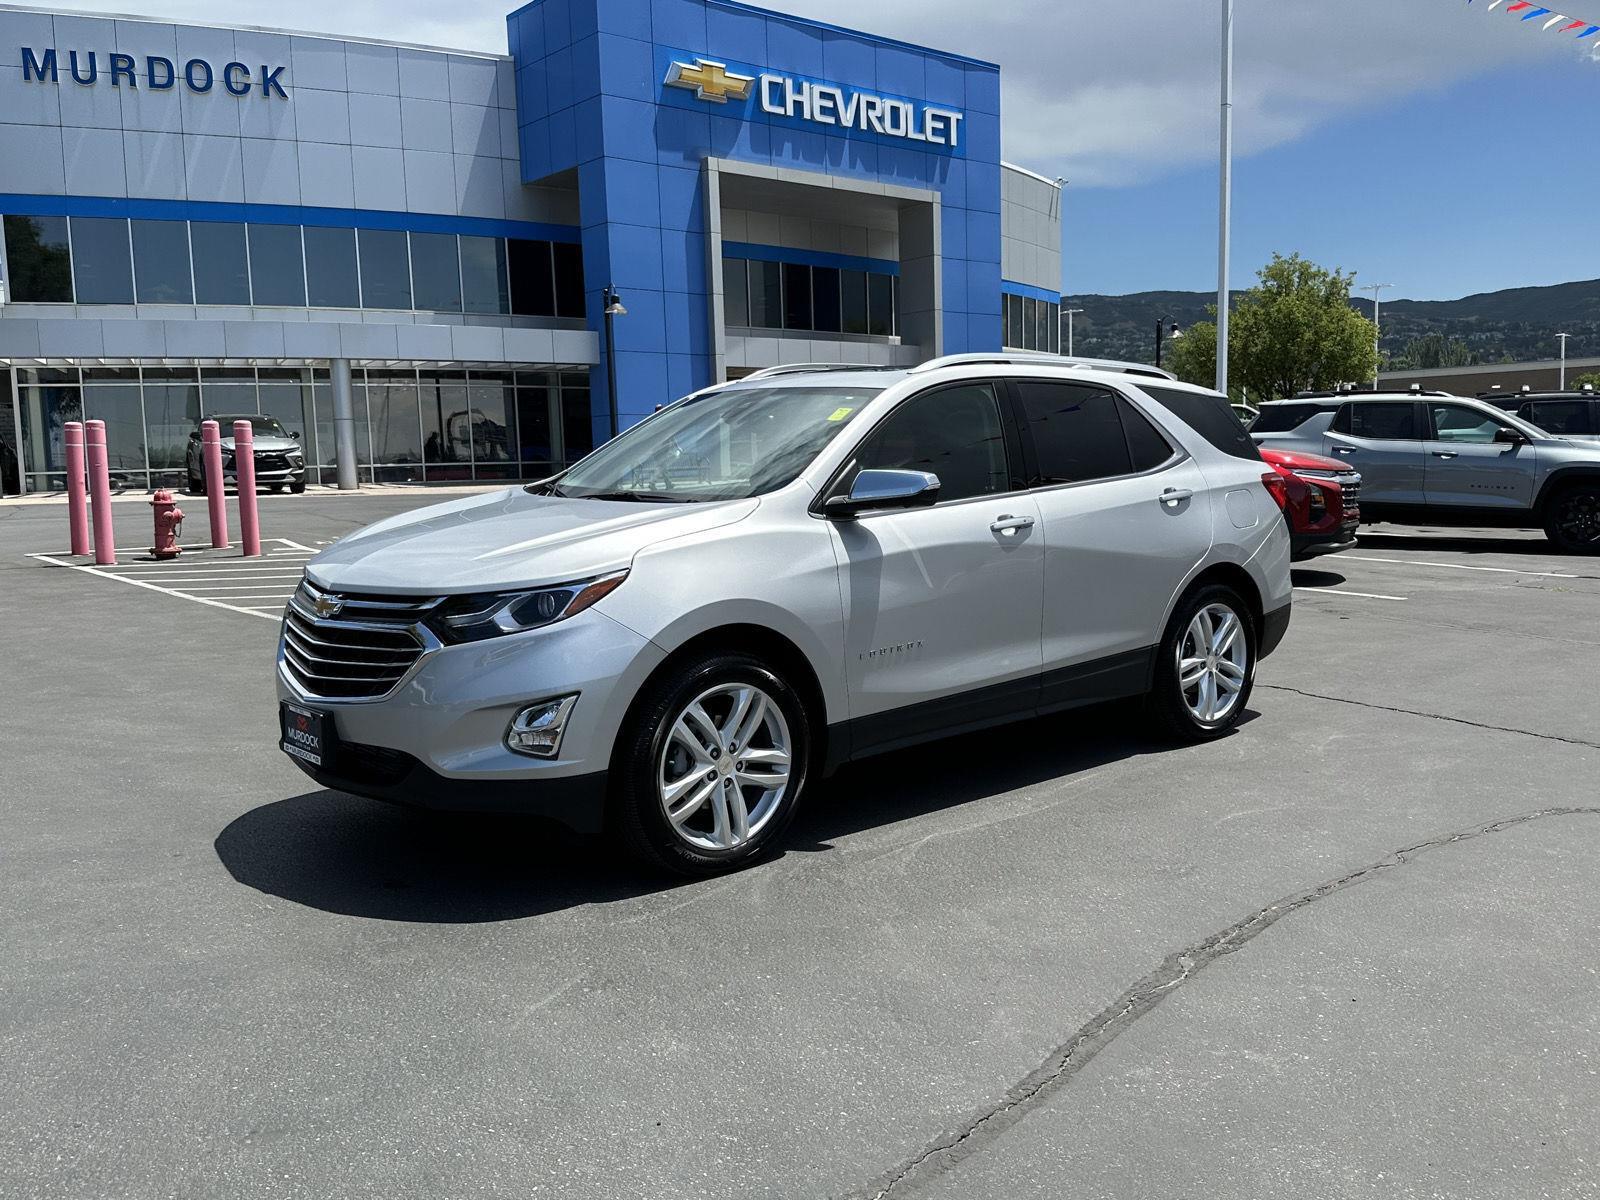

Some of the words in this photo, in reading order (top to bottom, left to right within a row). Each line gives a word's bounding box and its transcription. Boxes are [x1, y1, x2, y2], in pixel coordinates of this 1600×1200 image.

[21, 47, 289, 99] MURDOCK
[759, 73, 963, 146] CHEVROLET
[288, 727, 319, 748] MURDOCK
